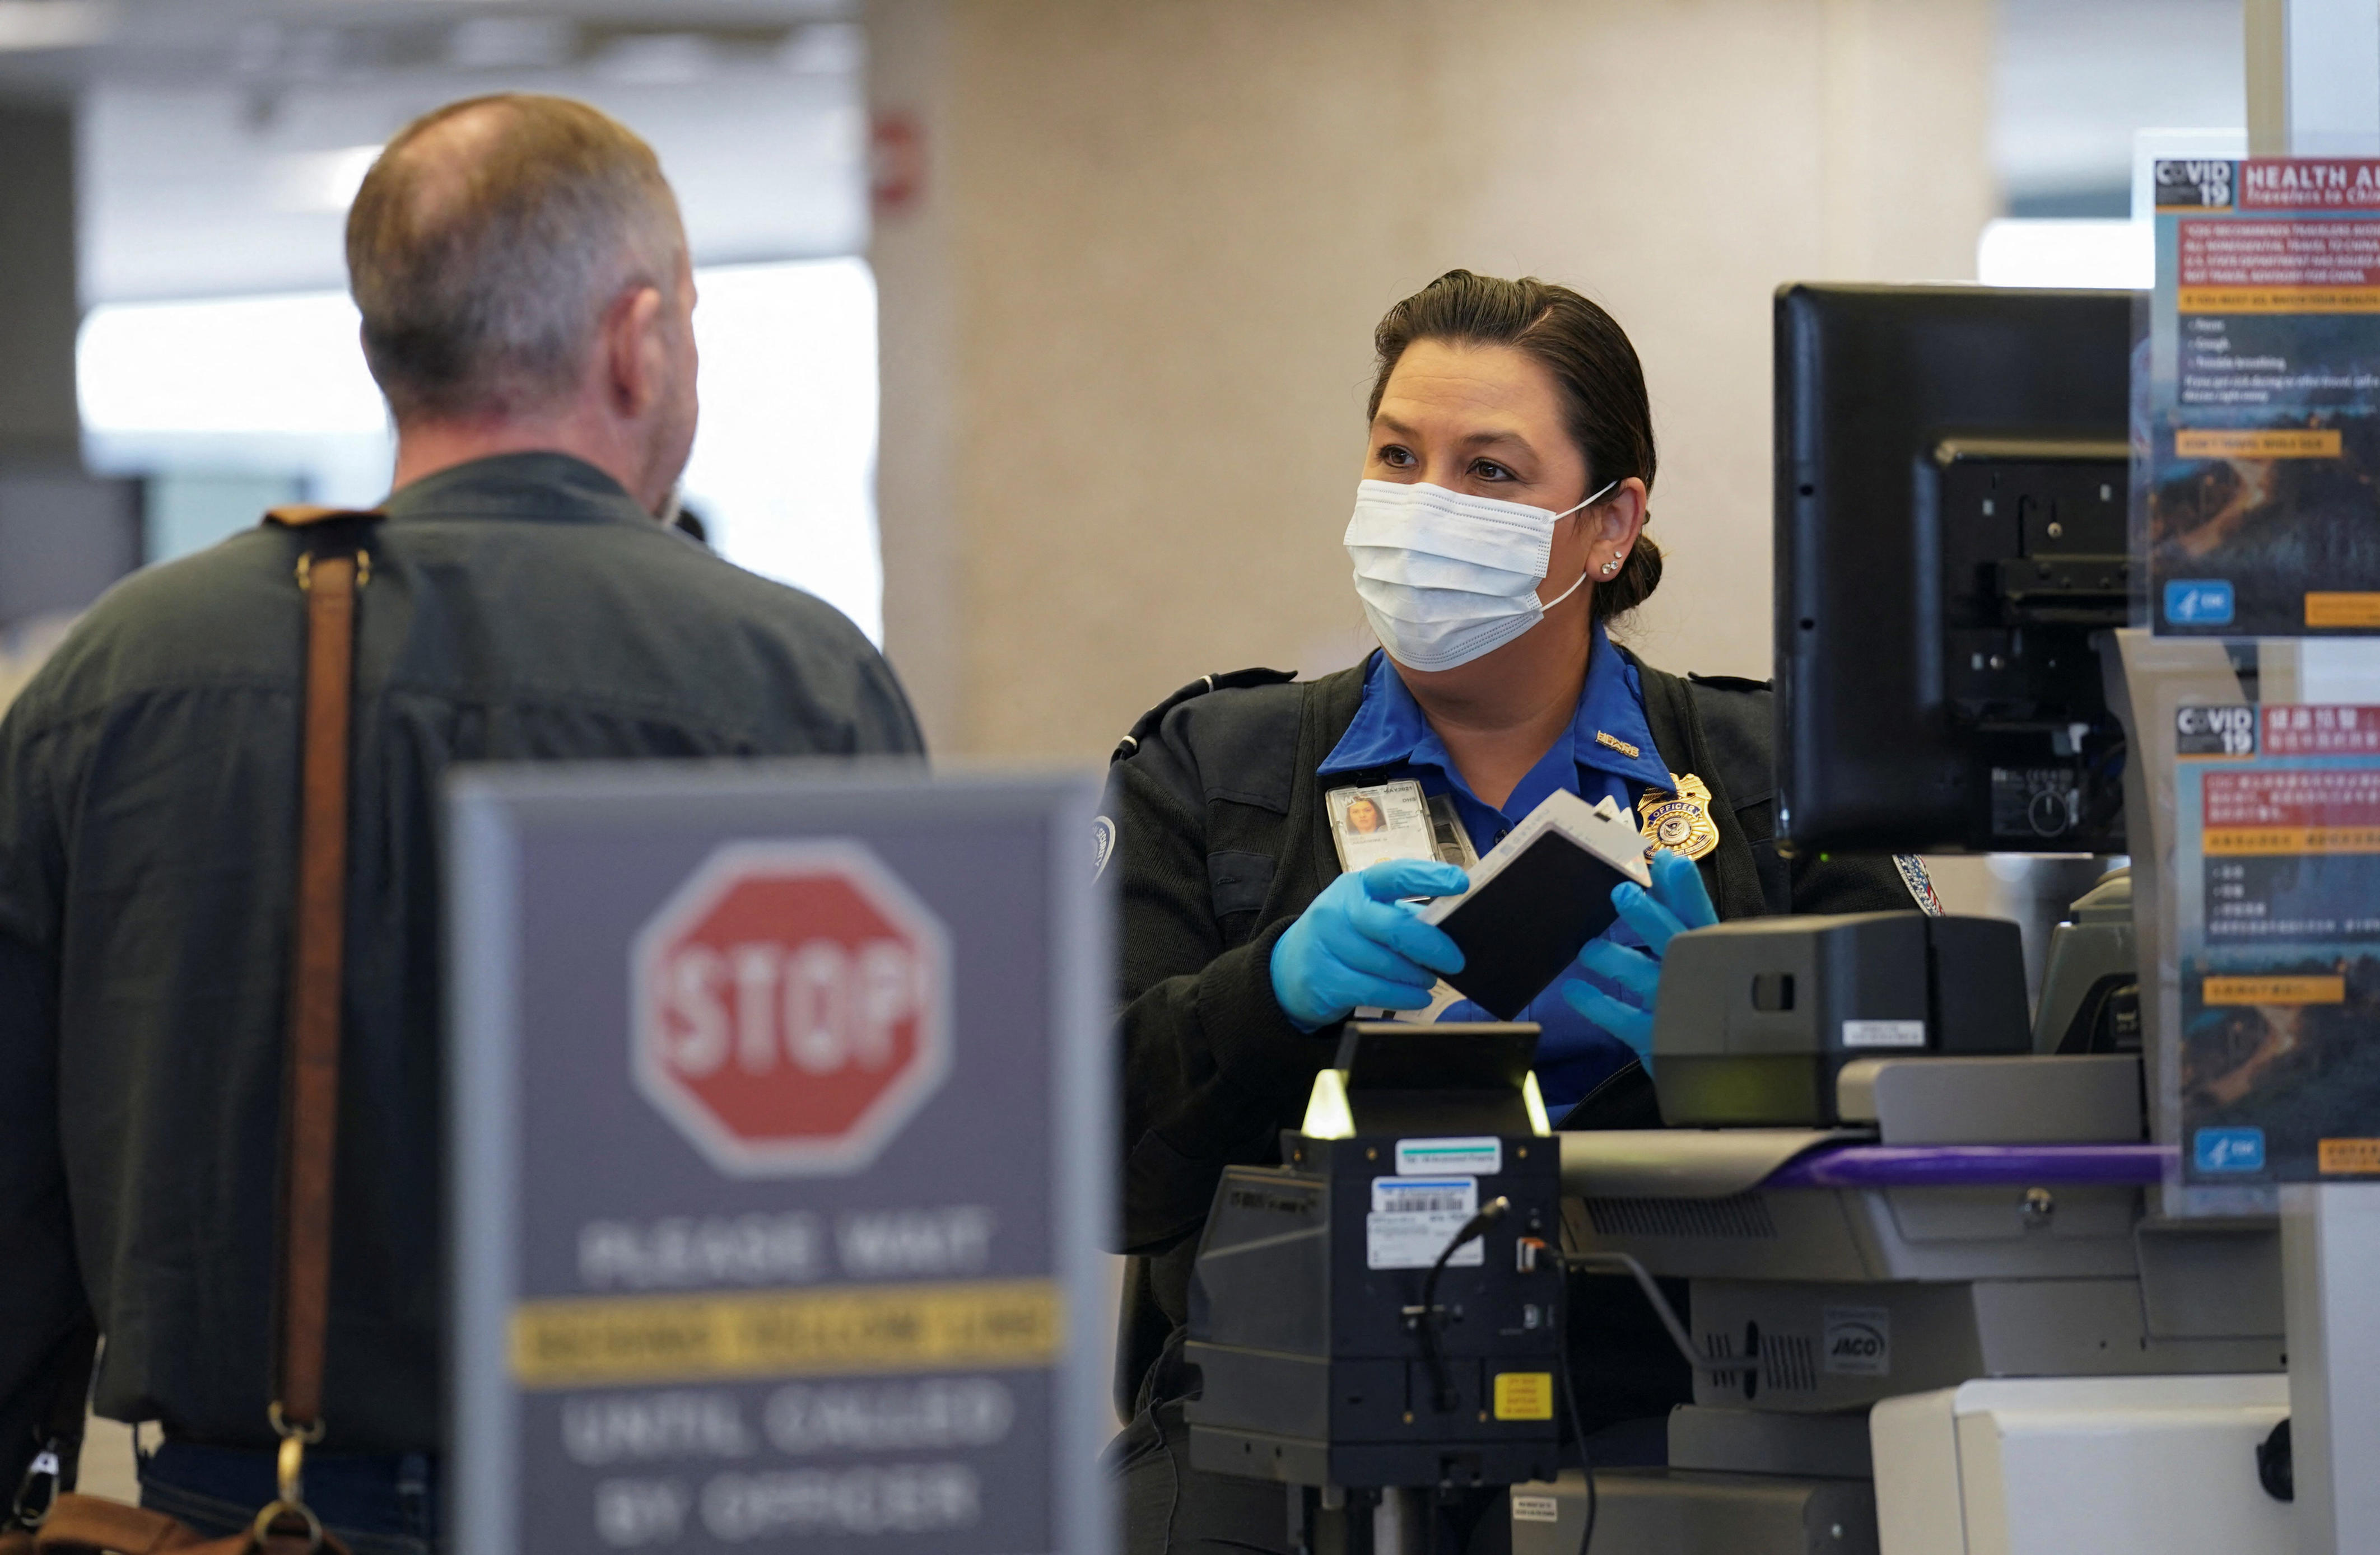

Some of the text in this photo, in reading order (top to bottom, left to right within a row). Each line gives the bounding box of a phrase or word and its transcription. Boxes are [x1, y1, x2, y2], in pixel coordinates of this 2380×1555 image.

[2246, 166, 2347, 188] HEALTH
[2200, 183, 2230, 206] 19
[2223, 730, 2253, 754] 19
[1653, 803, 1695, 817] OFFICER
[669, 948, 923, 1071] STOP
[1832, 1337, 1876, 1356] JACO
